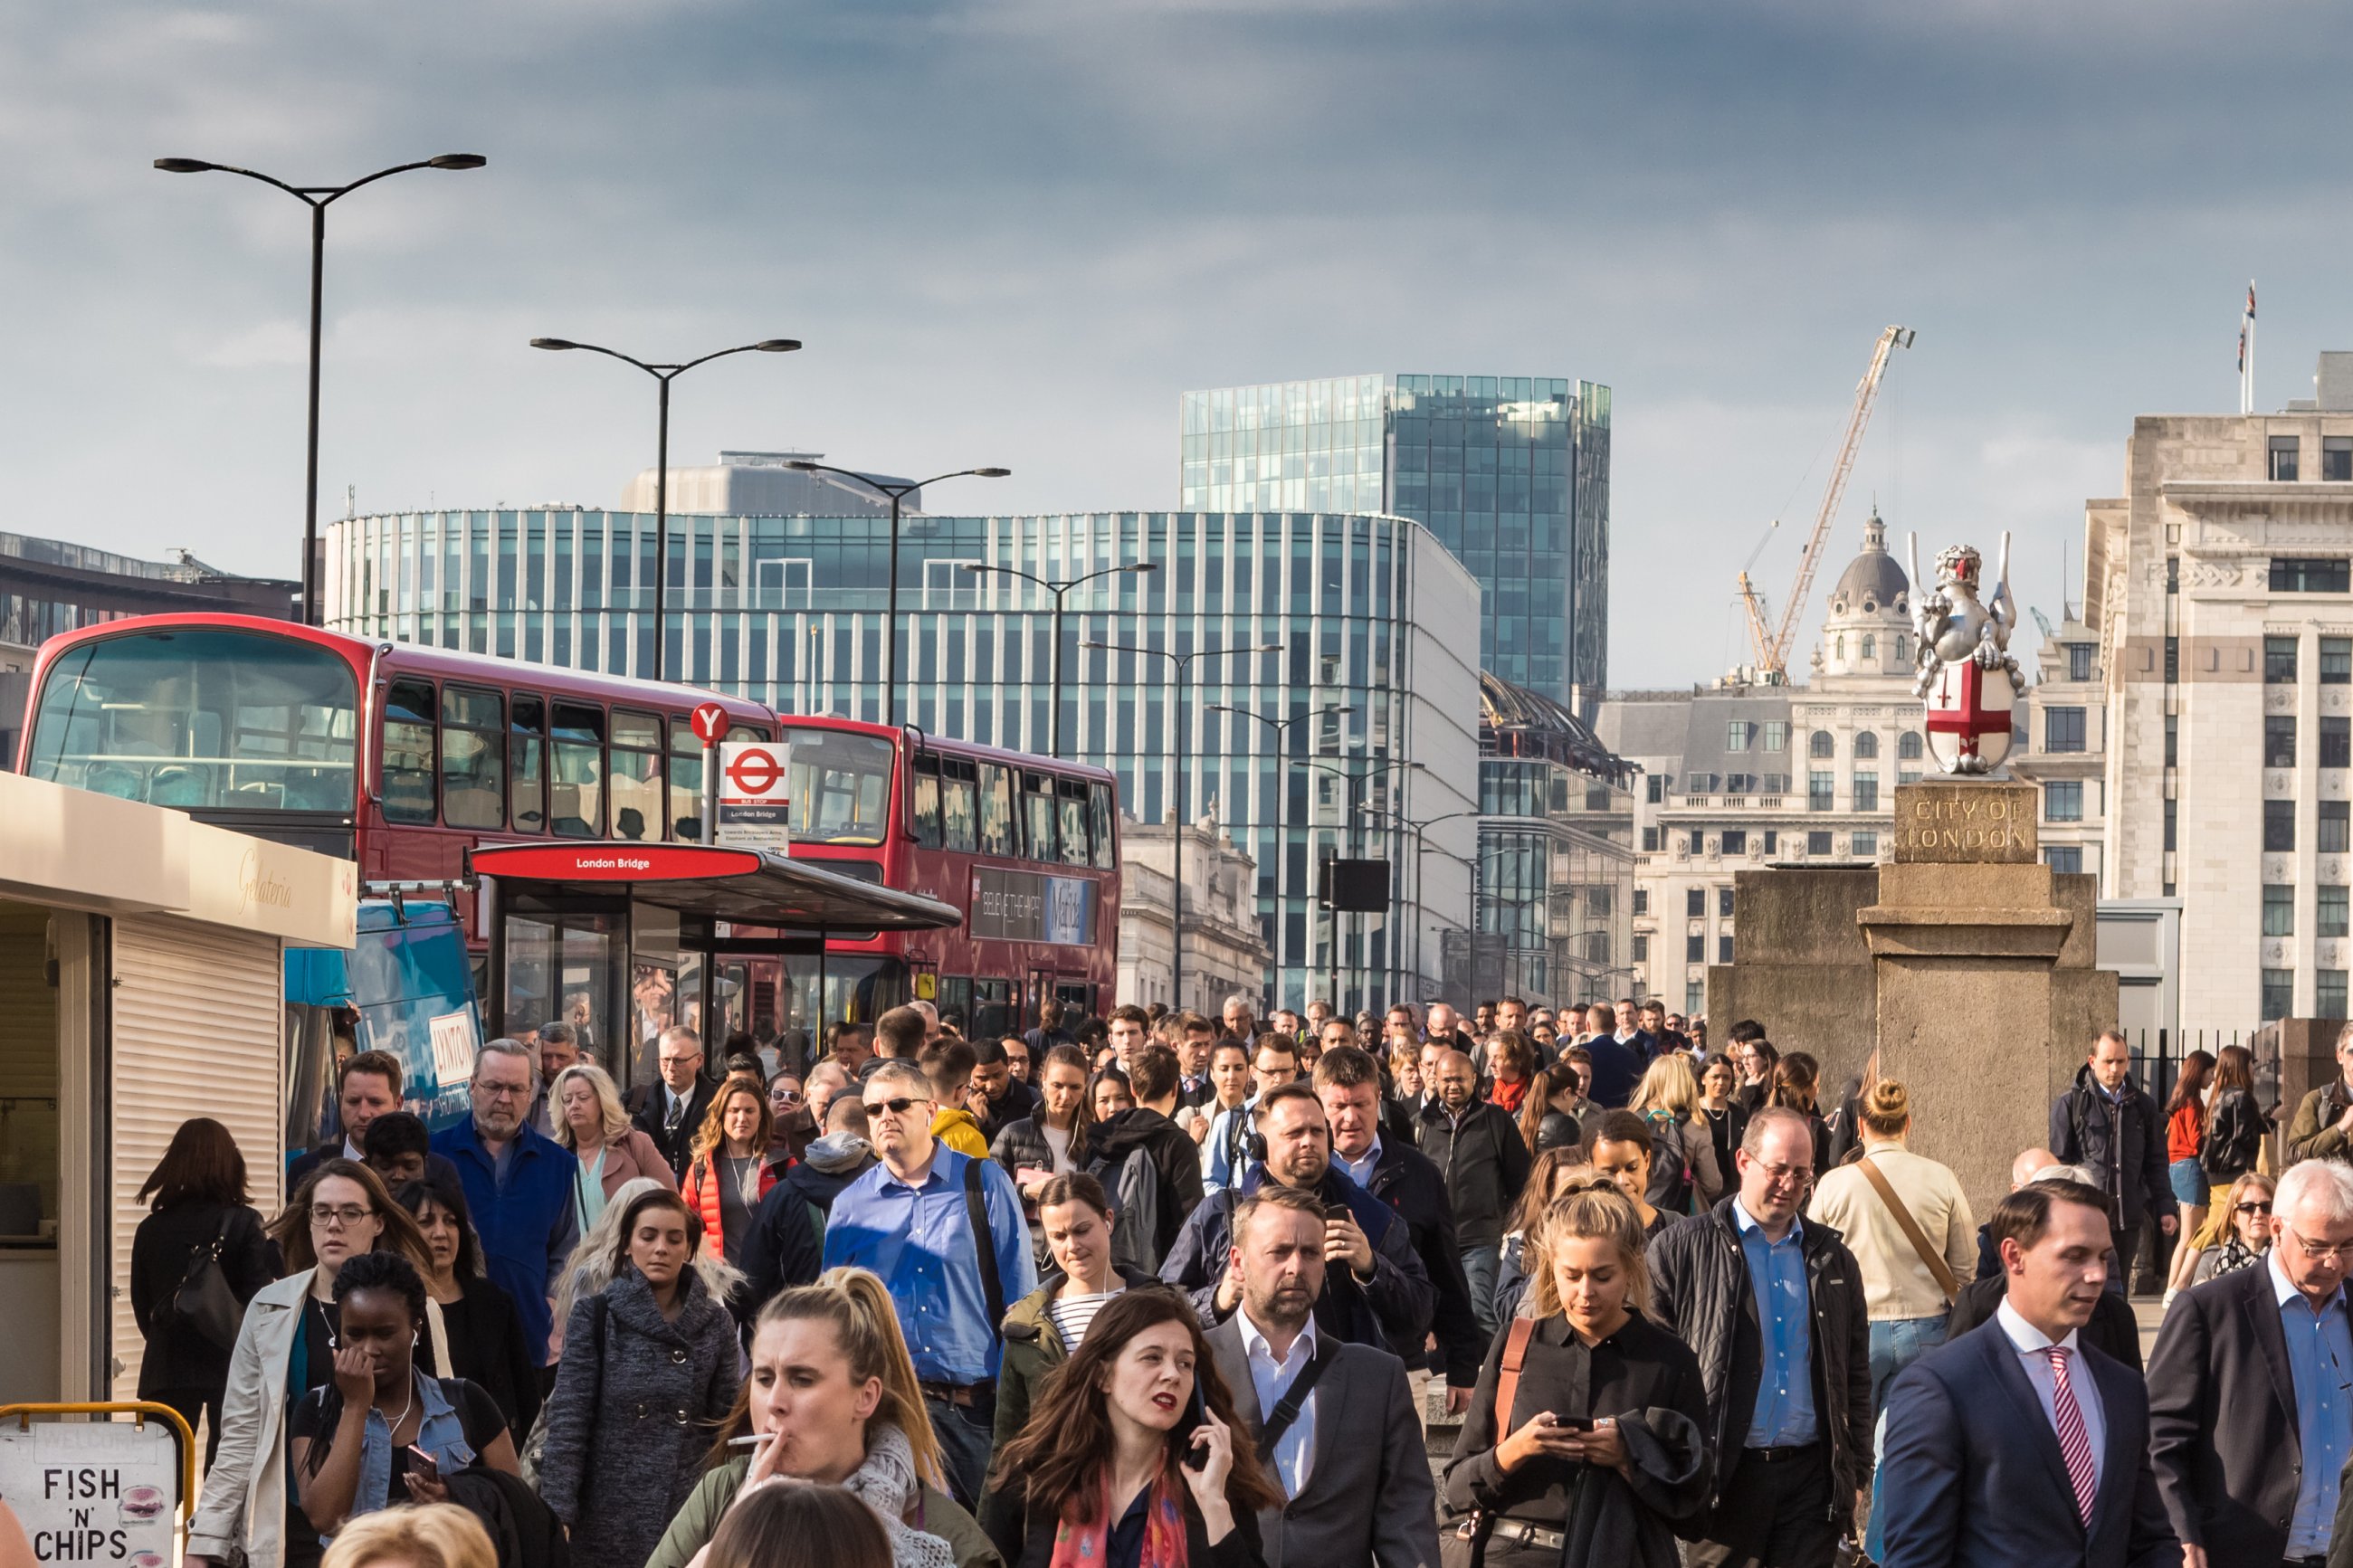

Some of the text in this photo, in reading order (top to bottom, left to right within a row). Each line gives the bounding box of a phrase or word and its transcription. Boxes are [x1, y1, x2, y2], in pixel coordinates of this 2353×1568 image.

[699, 708, 721, 736] Y
[756, 811, 776, 819] Bridge
[1916, 800, 2023, 820] CITY OF
[1908, 828, 2026, 849] LONDON
[576, 859, 650, 870] London Bridge
[238, 848, 291, 916] Gelateria
[433, 1023, 473, 1074] LYNTON
[44, 1468, 119, 1500] FISH
[69, 1506, 95, 1528] 'N'
[34, 1530, 128, 1562] CHIPS
